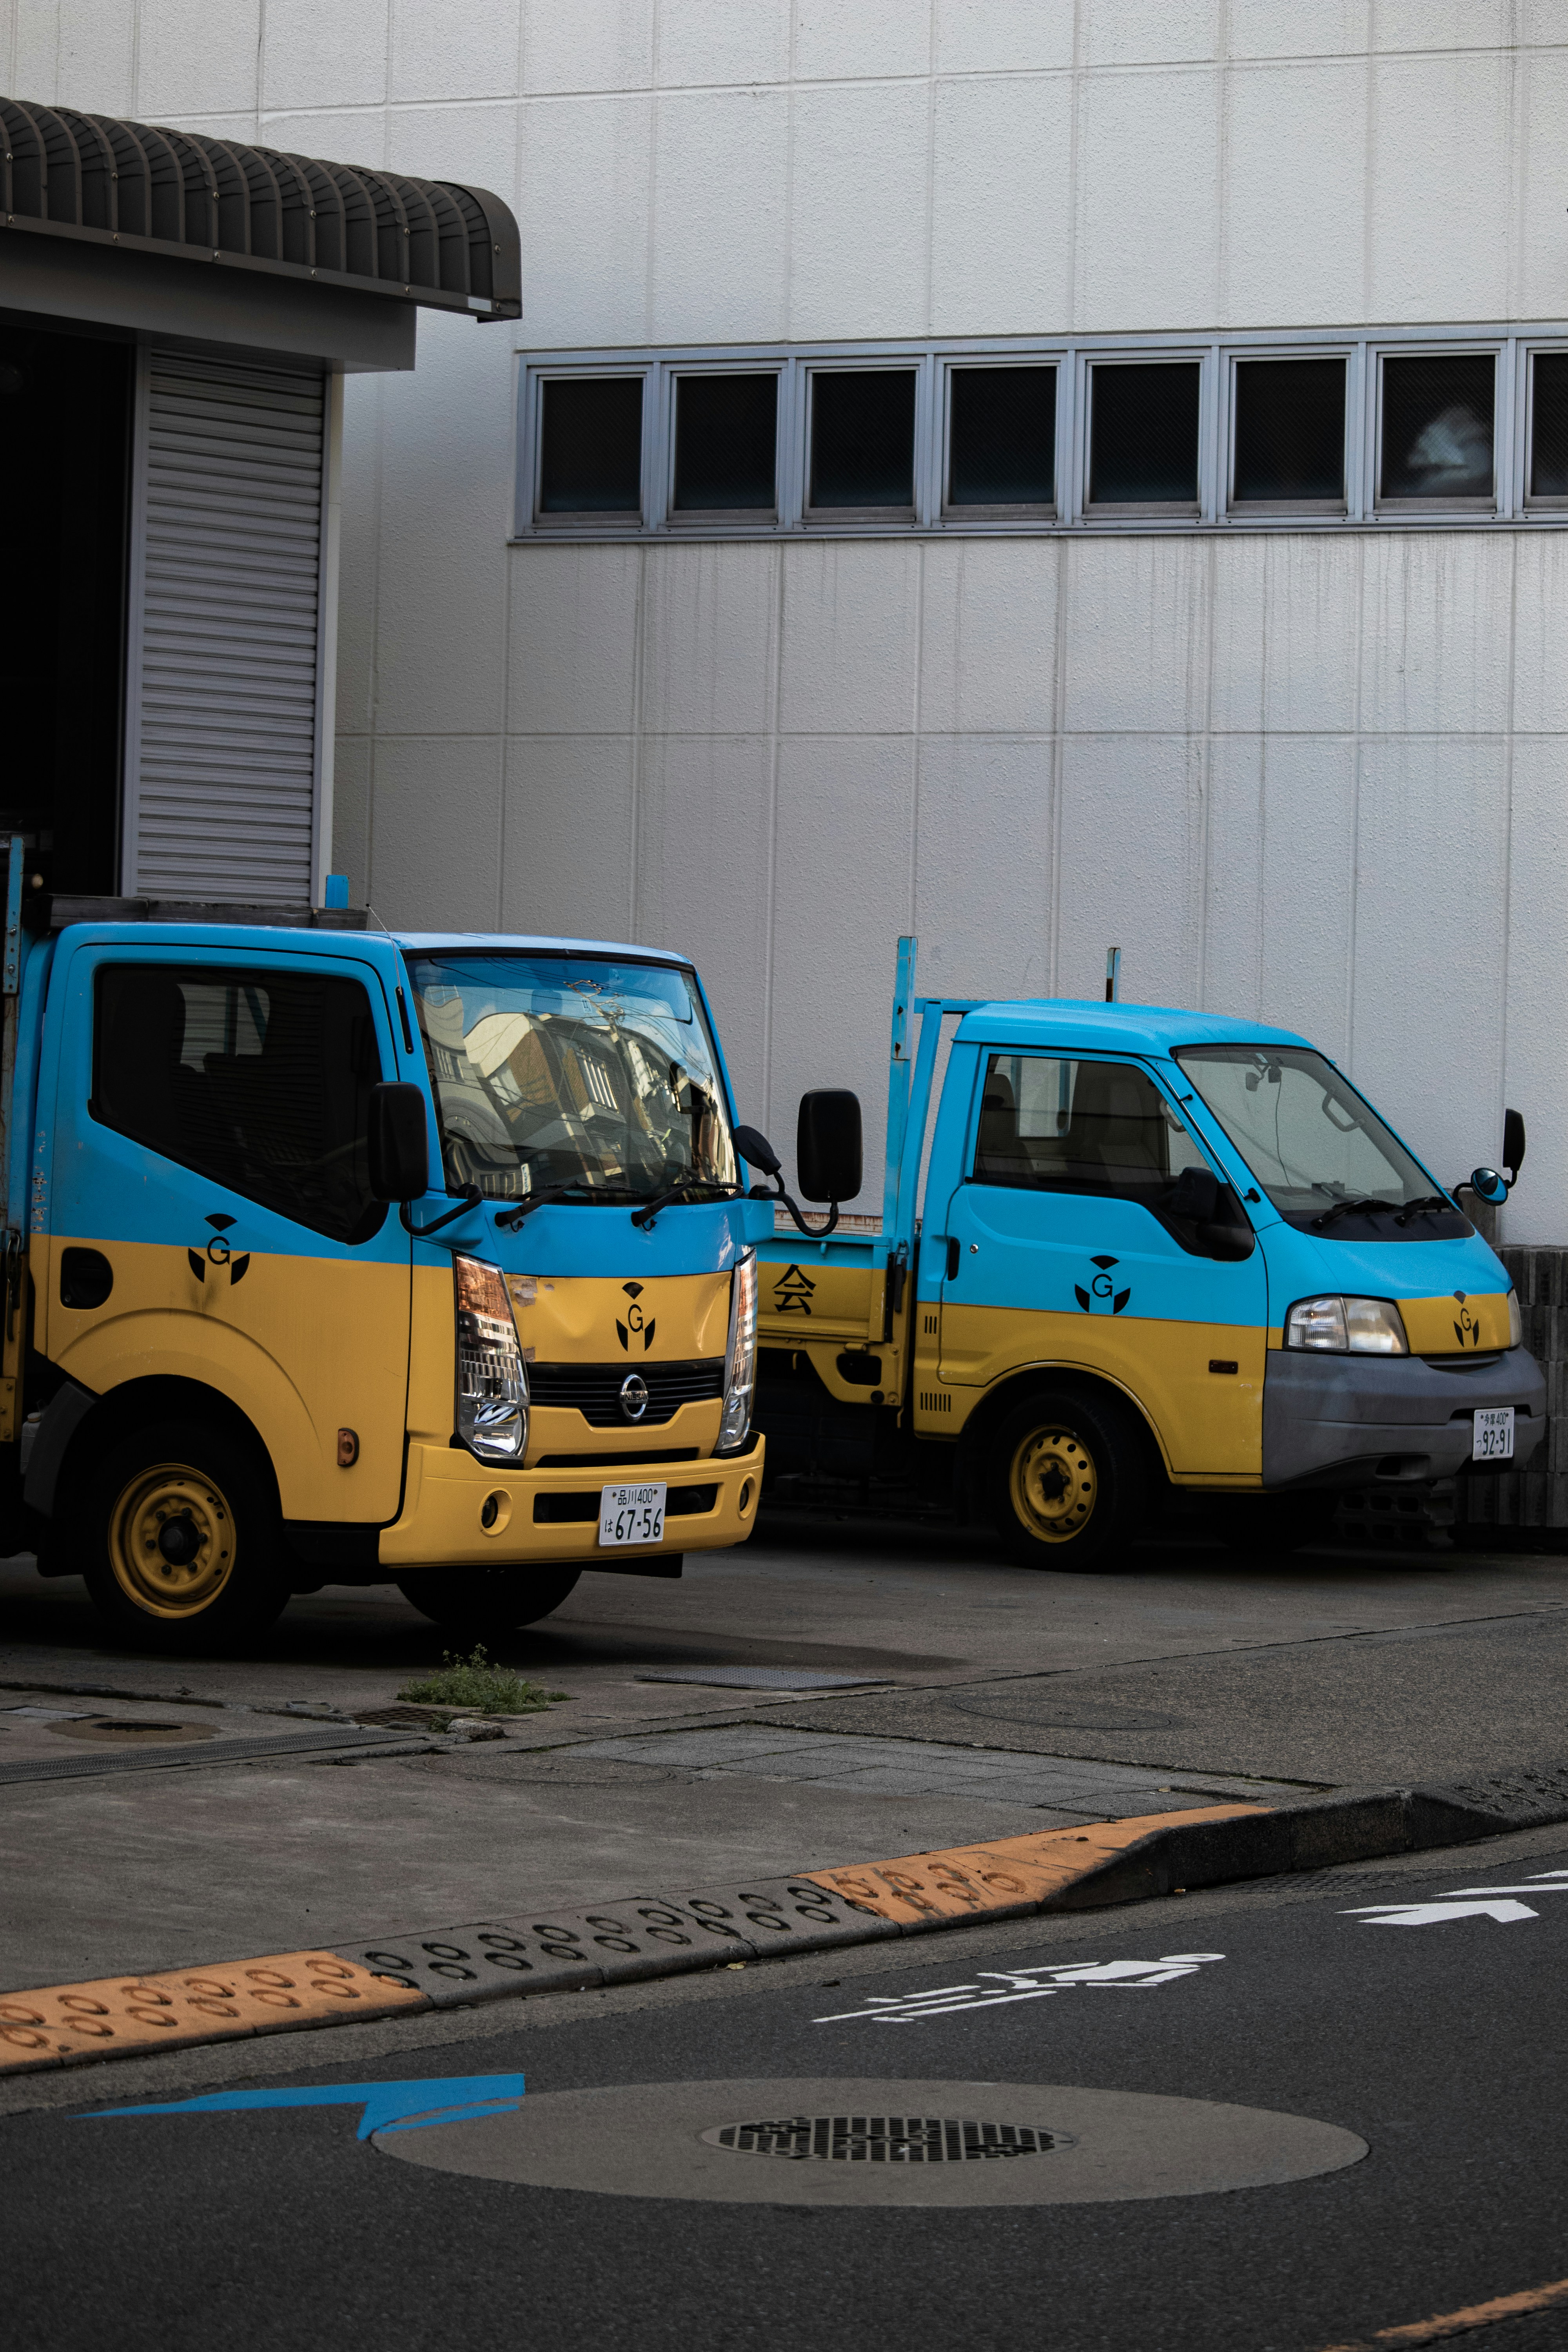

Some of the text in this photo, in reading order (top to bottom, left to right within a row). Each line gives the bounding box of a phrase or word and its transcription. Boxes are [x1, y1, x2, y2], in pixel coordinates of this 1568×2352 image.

[207, 1236, 230, 1265] G
[772, 1264, 817, 1315] 会
[1092, 1274, 1112, 1298] G
[628, 1304, 643, 1332] G
[1460, 1308, 1472, 1331] G
[624, 1392, 648, 1401] NISSAN
[605, 1519, 613, 1533] は
